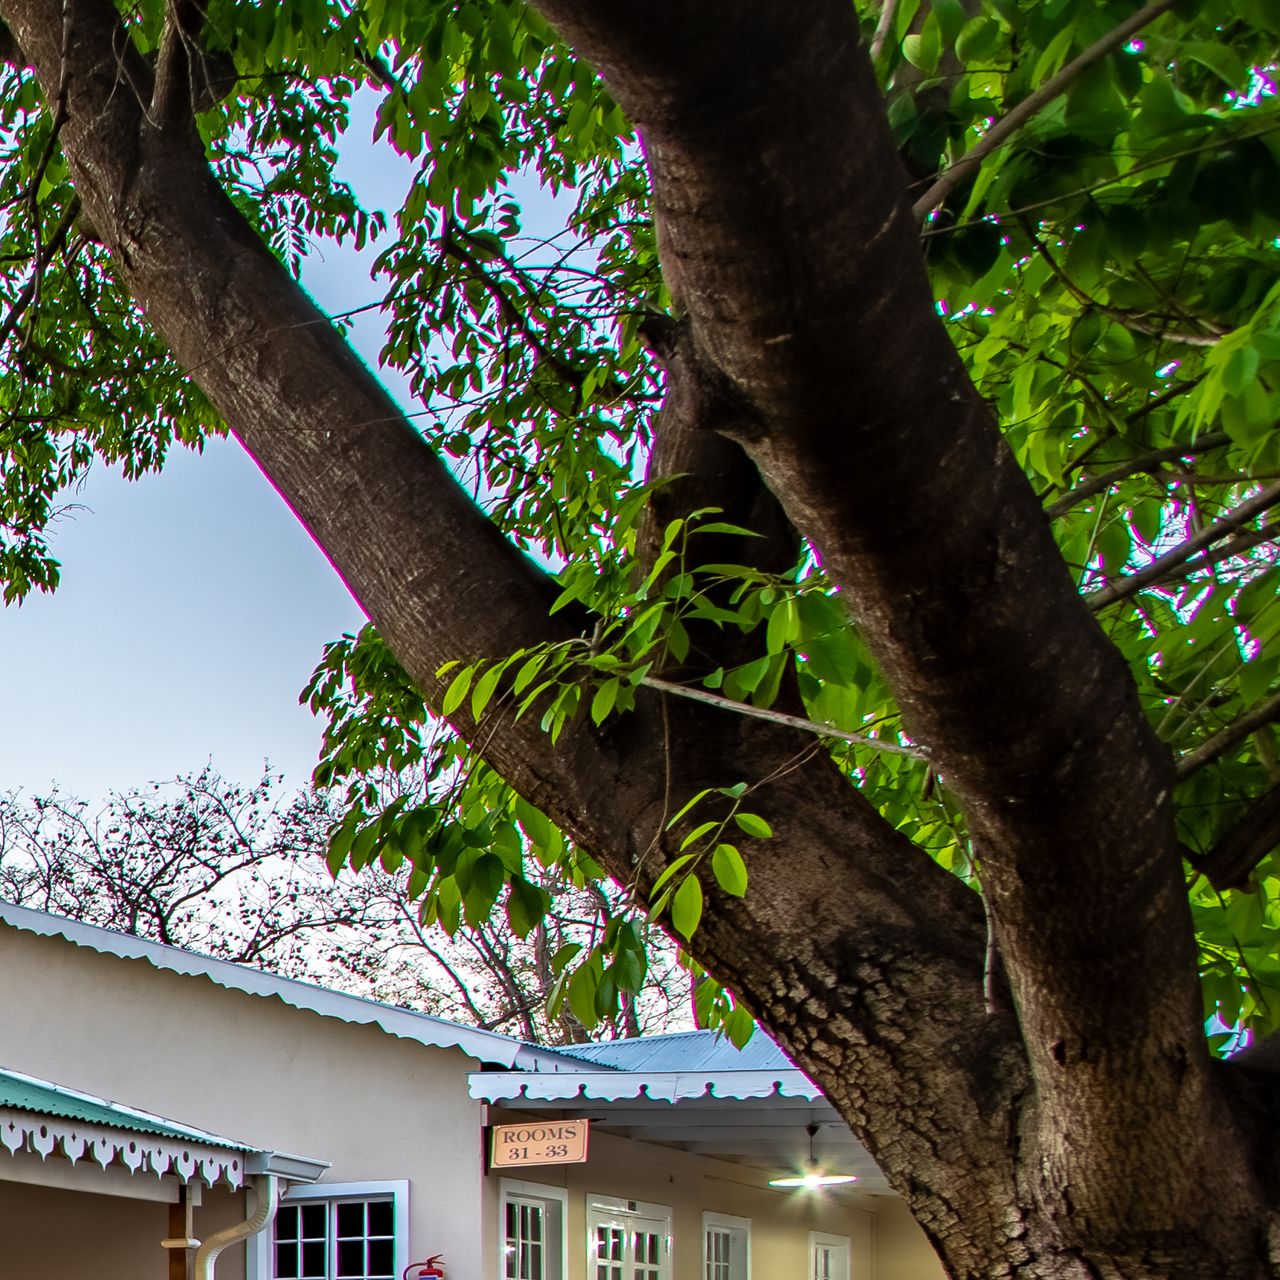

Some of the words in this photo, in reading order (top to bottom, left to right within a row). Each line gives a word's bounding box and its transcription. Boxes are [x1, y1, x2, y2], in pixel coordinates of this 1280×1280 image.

[503, 1126, 577, 1144] ROOMS
[509, 1147, 528, 1160] 31
[545, 1144, 568, 1158] 33
